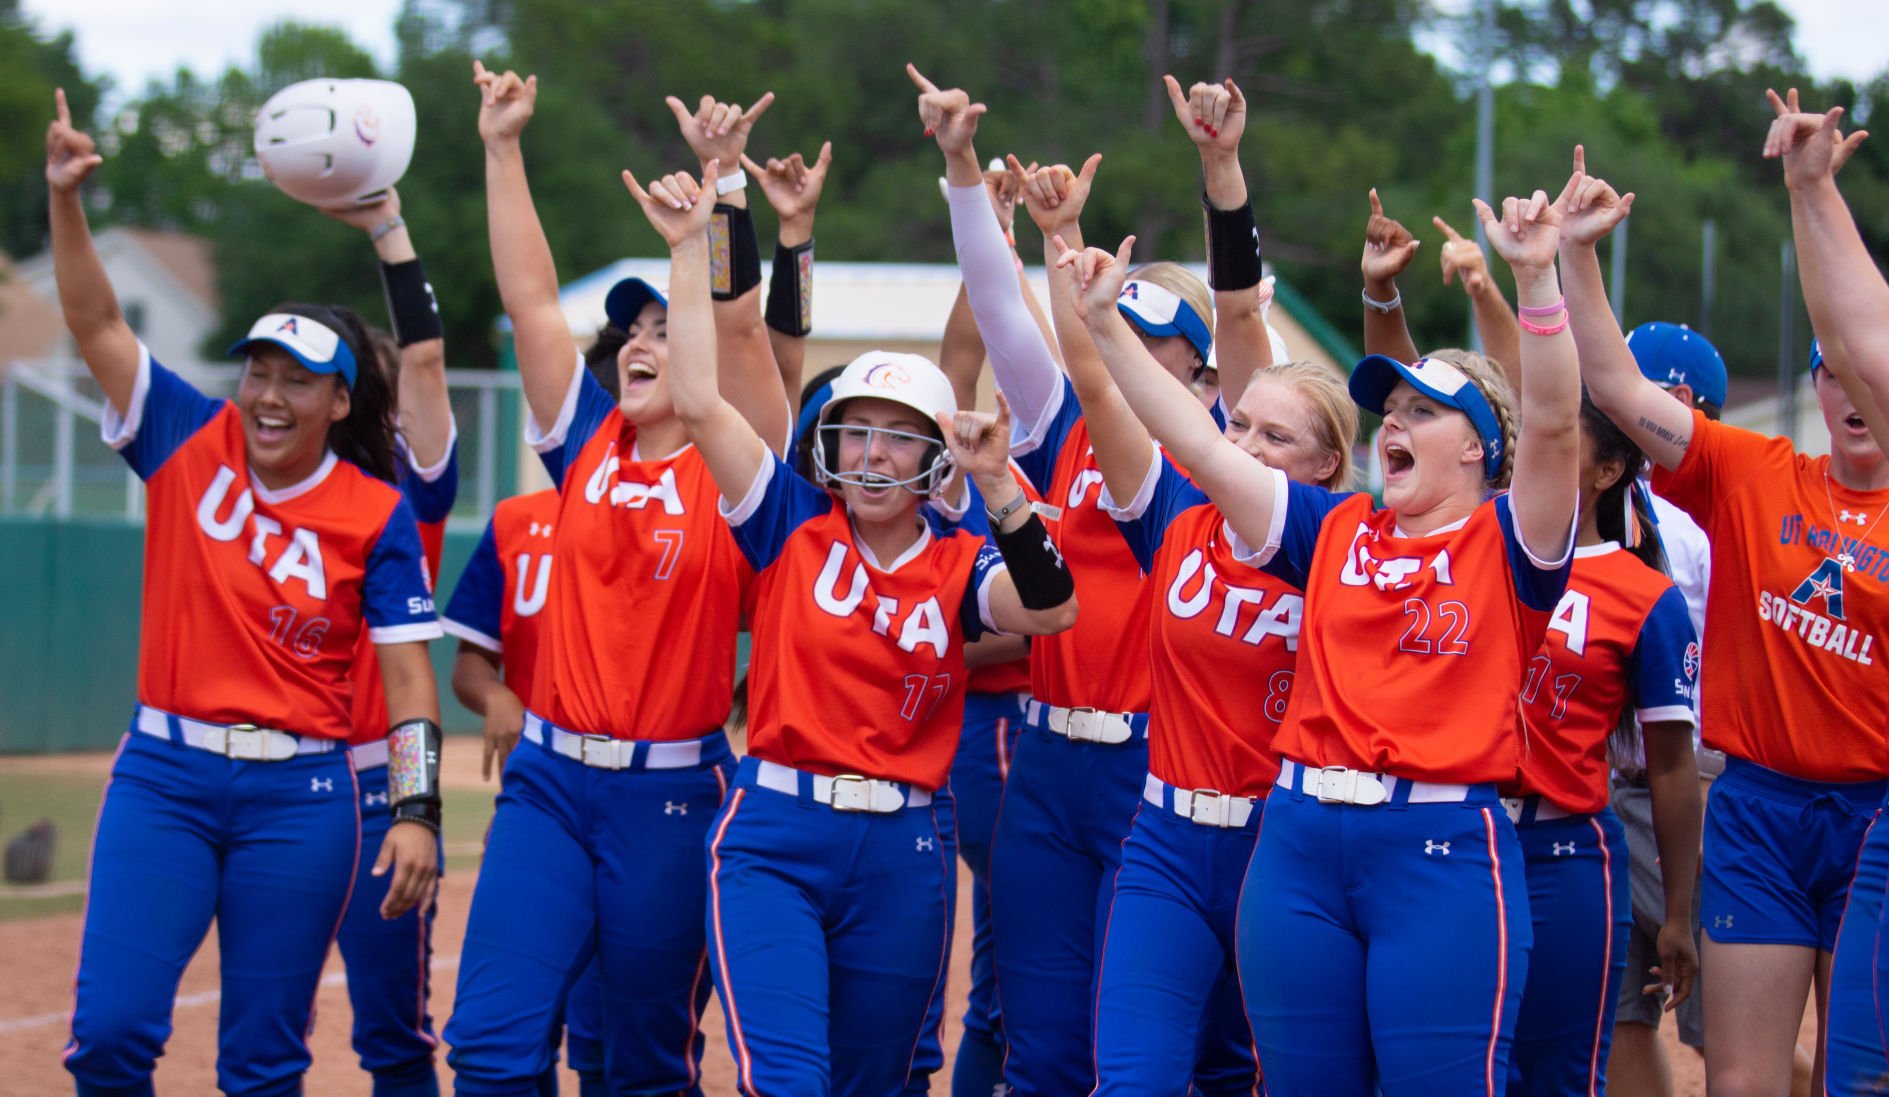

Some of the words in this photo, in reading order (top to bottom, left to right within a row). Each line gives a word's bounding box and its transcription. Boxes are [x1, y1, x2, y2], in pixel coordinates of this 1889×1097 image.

[198, 464, 326, 600] UTA
[654, 529, 683, 580] 7
[1779, 514, 1803, 545] UT
[269, 605, 331, 659] 16
[813, 538, 949, 659] UTA
[1167, 547, 1305, 651] UTA
[1400, 597, 1470, 656] 22
[1758, 590, 1873, 665] SOFTBALL
